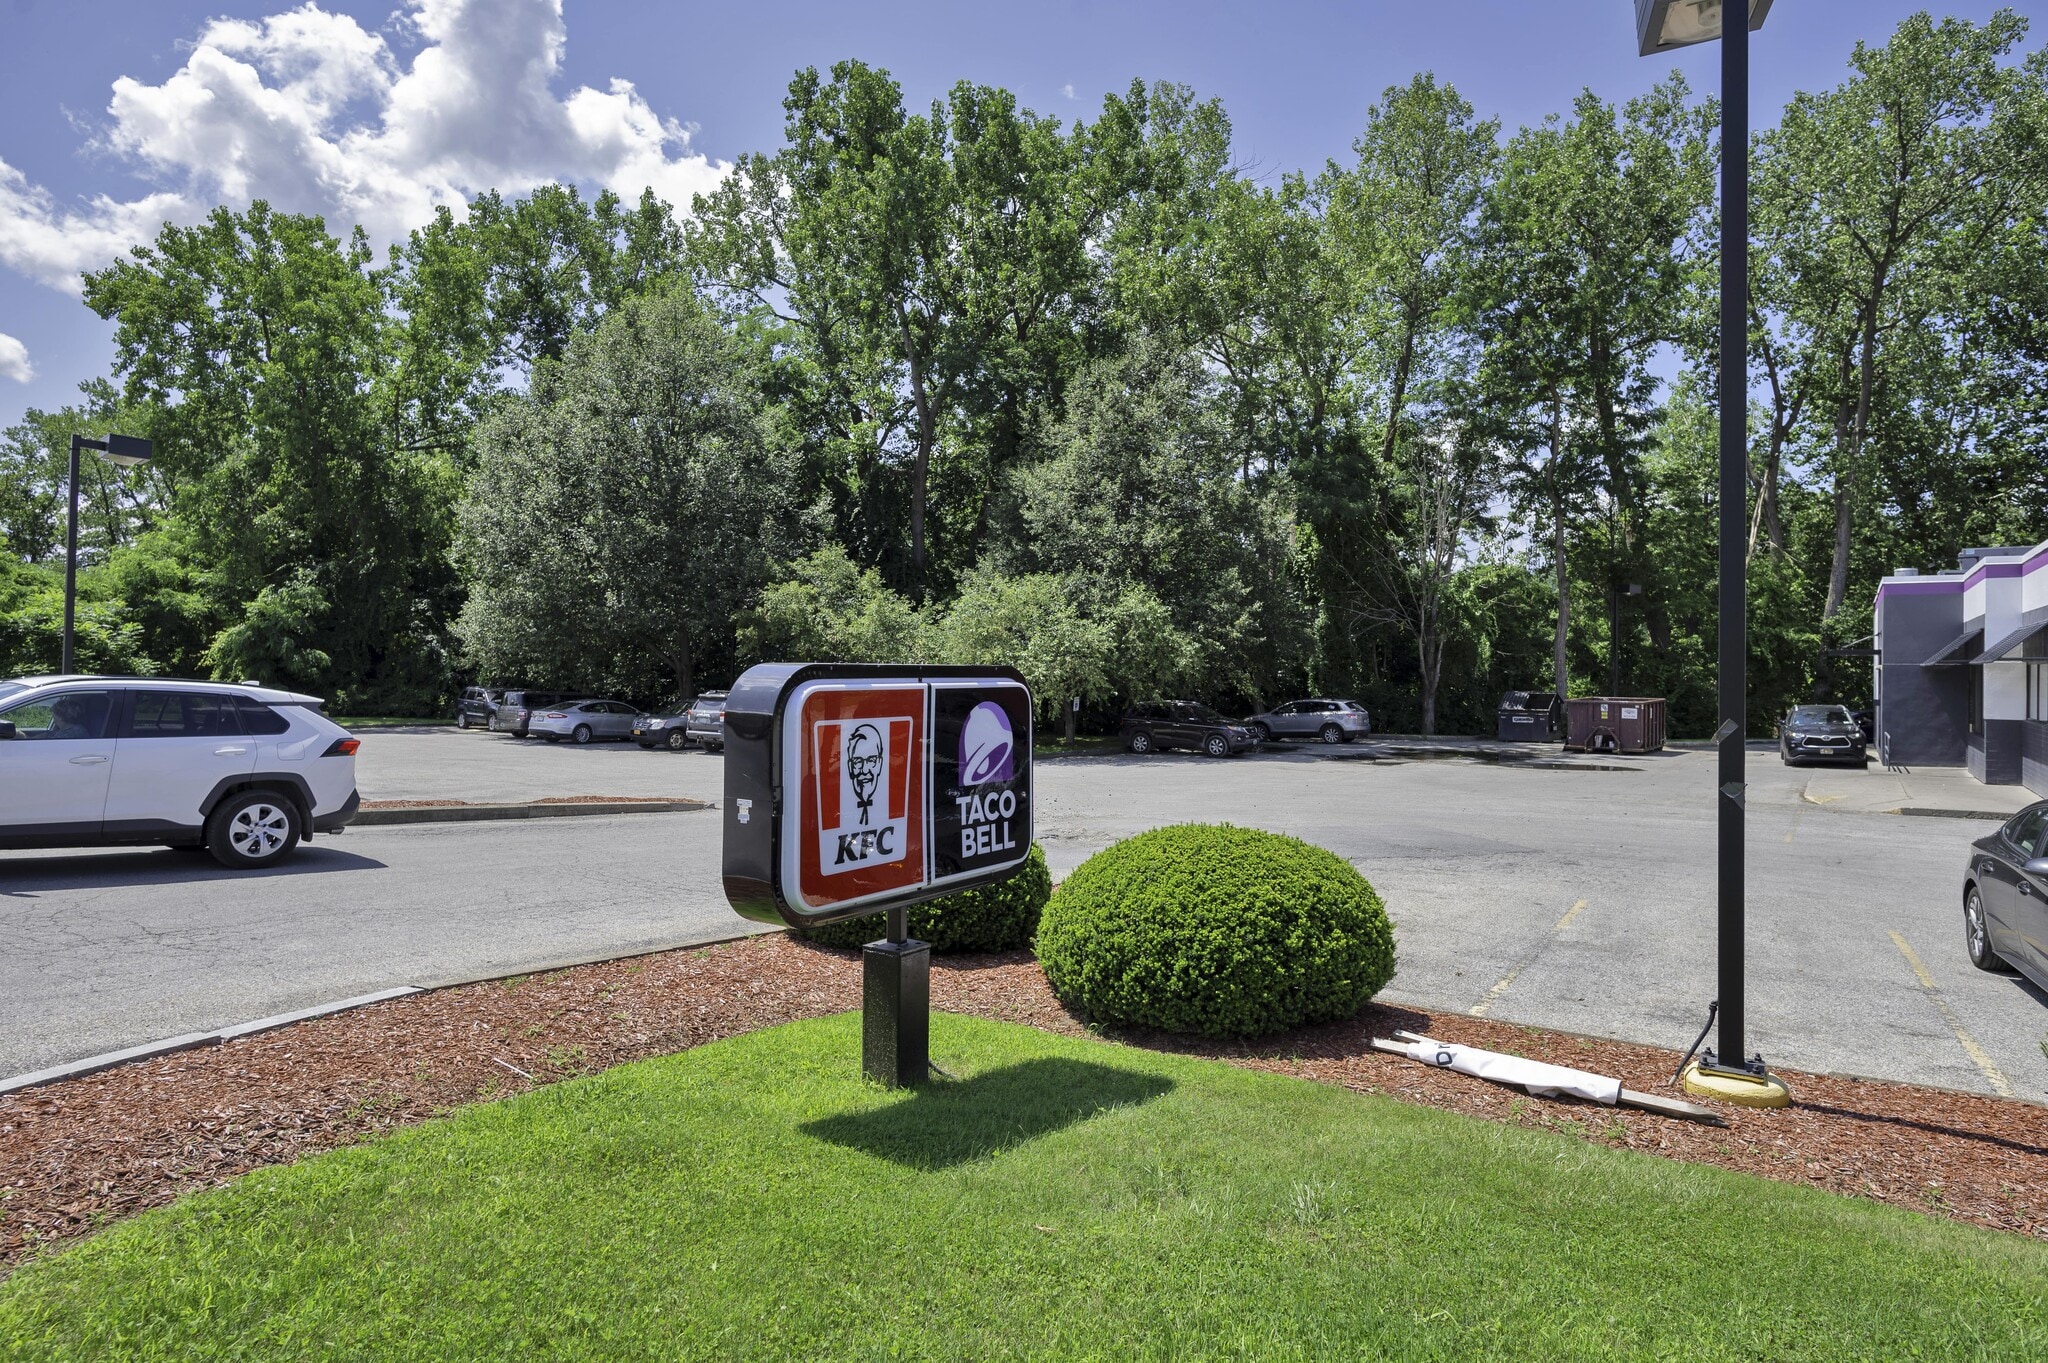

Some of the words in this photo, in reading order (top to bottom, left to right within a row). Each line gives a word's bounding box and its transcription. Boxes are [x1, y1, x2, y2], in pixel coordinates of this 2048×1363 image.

[956, 790, 1016, 826] TACO
[834, 826, 895, 865] KFC
[961, 821, 1016, 858] BELL
